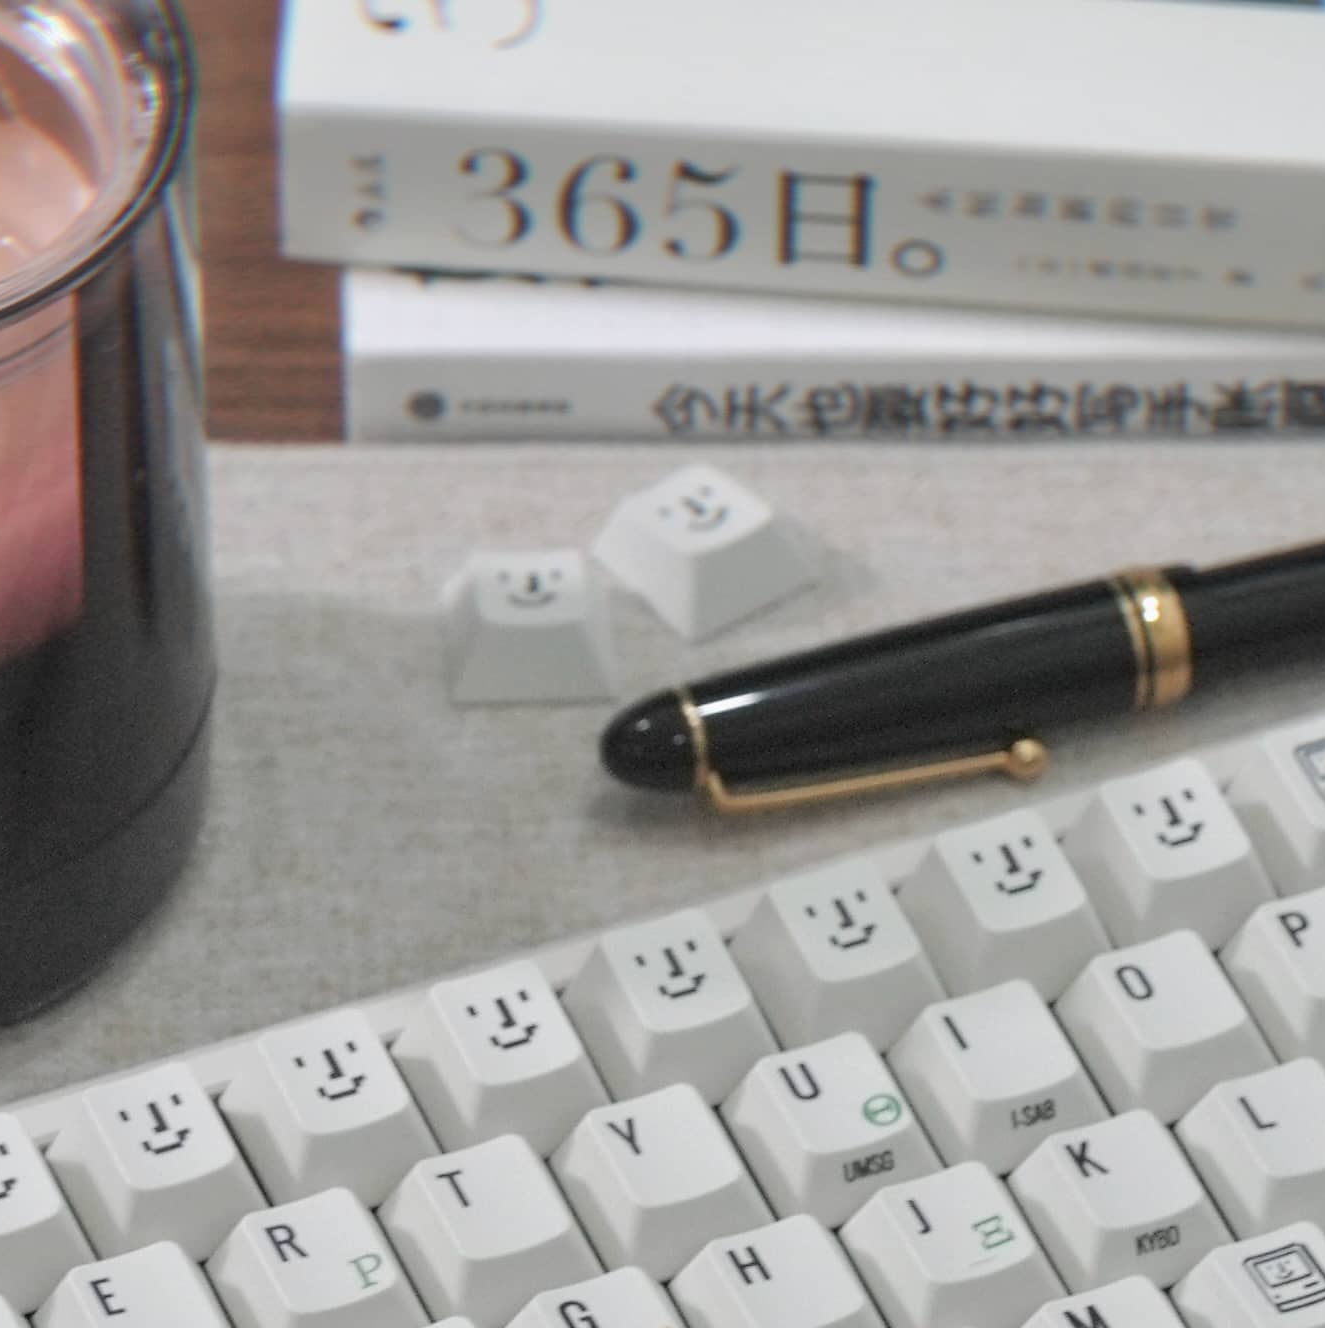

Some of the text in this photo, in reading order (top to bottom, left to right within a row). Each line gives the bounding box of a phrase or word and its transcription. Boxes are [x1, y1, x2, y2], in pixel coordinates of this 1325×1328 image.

[1279, 911, 1309, 948] P
[779, 1062, 822, 1101] U
[1238, 1095, 1278, 1131] L
[607, 1117, 644, 1157] Y
[1064, 1140, 1109, 1178] K
[436, 1168, 472, 1209] T
[906, 1198, 932, 1235] J
[264, 1223, 309, 1263] R
[726, 1245, 772, 1286] H
[88, 1276, 127, 1318] E
